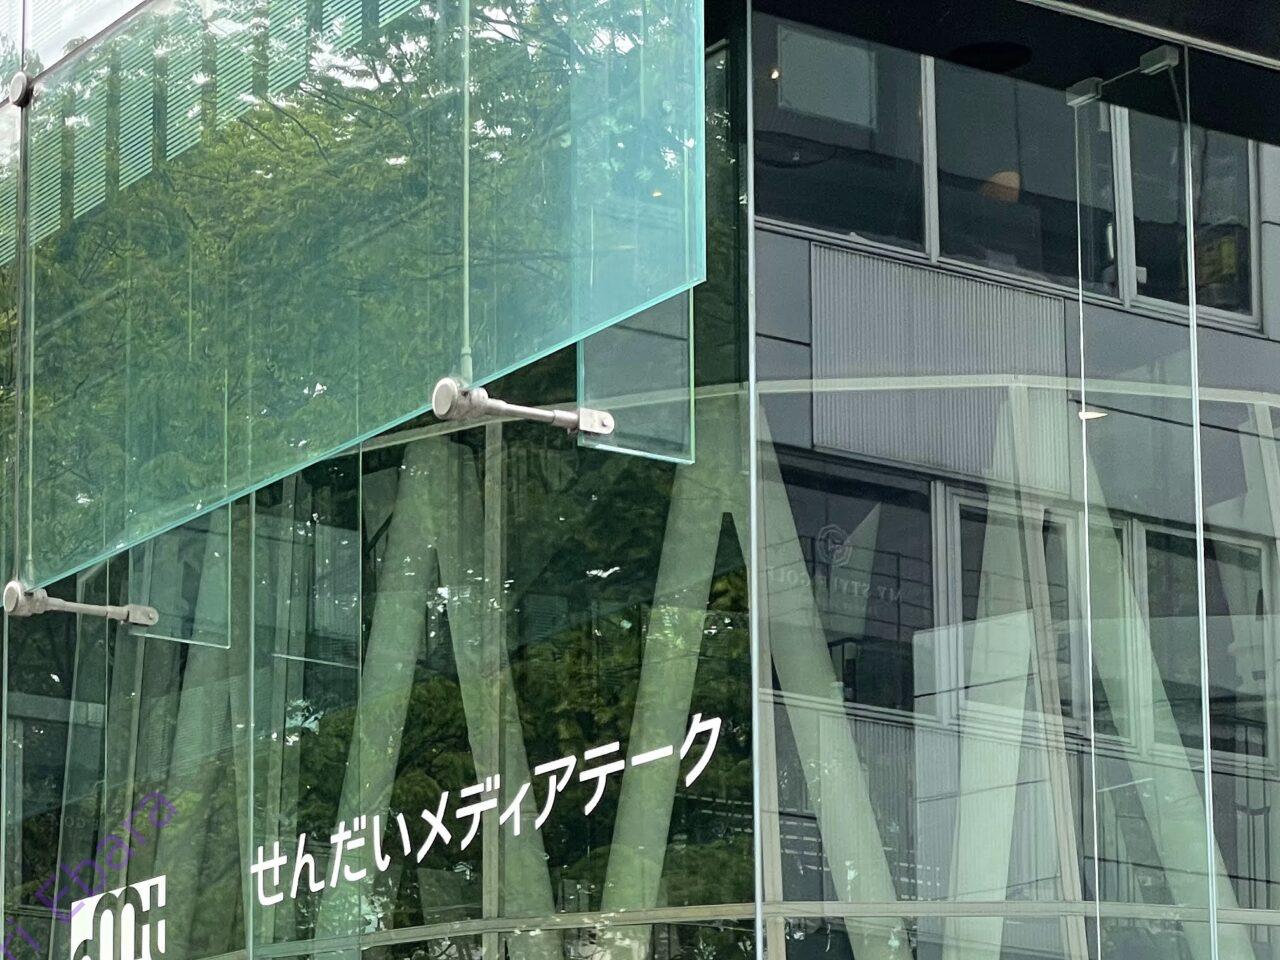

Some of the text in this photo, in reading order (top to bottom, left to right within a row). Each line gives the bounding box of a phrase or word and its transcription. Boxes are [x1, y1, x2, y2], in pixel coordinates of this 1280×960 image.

[252, 712, 722, 906] せんだいメディアテーク
